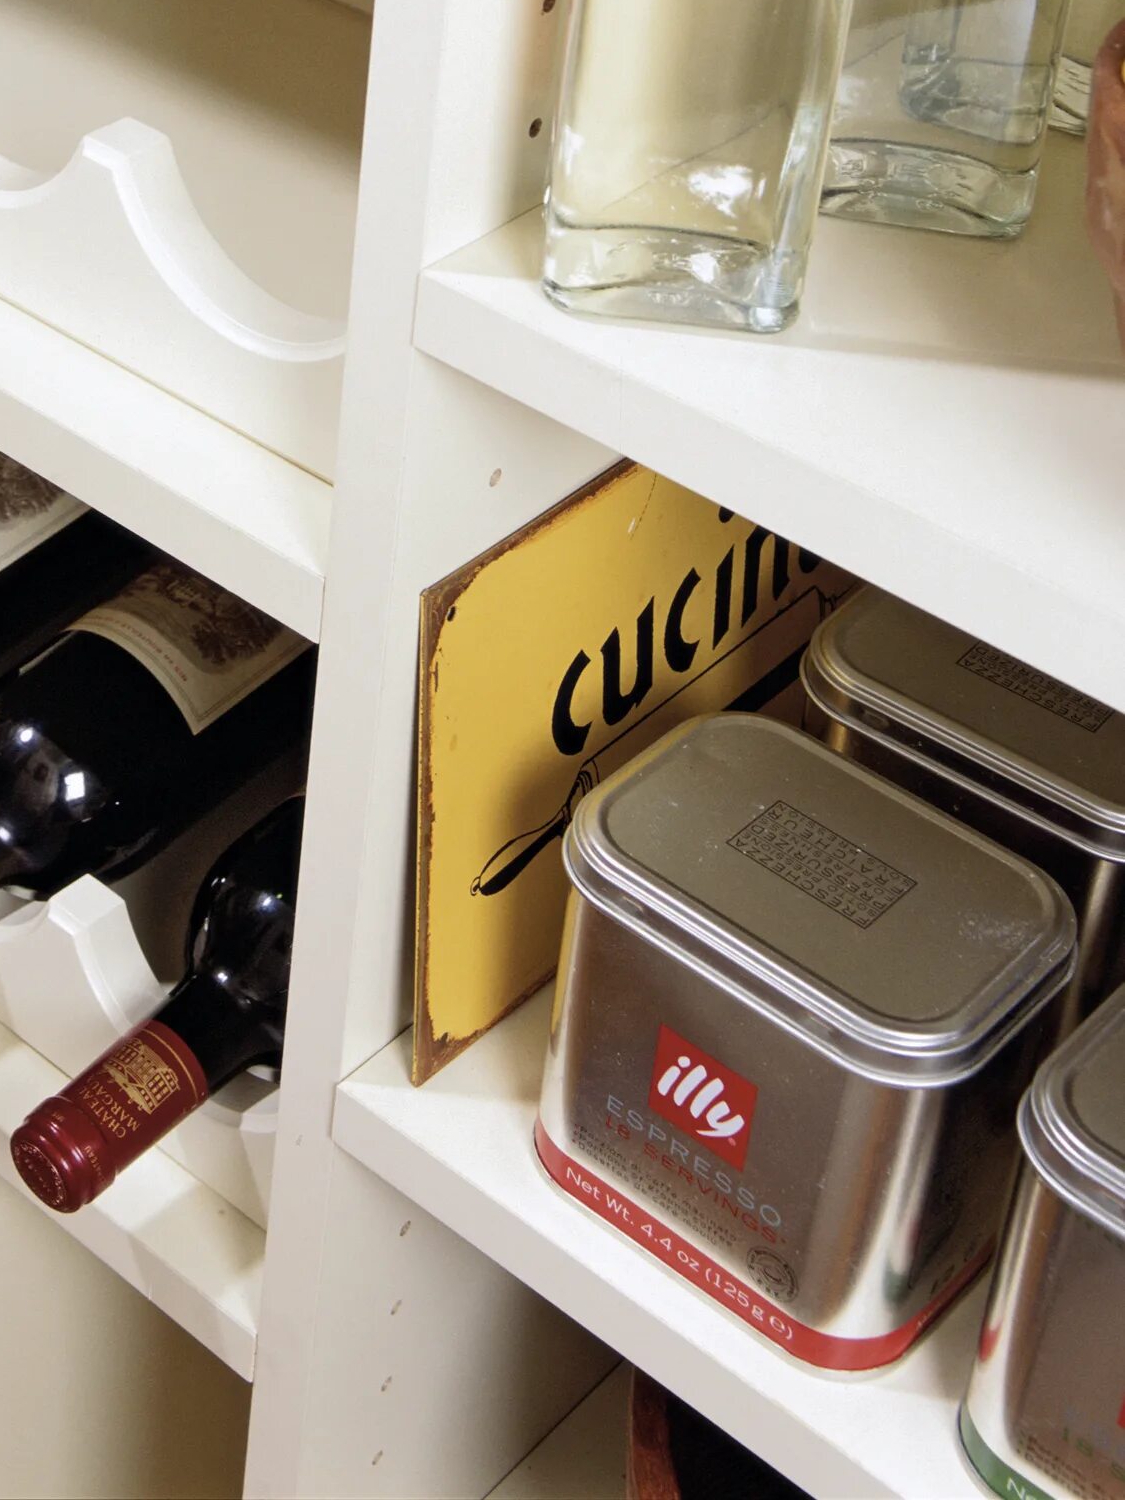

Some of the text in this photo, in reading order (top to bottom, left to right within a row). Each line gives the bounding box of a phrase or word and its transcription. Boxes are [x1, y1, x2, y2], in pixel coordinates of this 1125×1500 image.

[552, 506, 824, 756] cucin
[735, 838, 868, 927] FRESCHEZZA
[742, 832, 823, 884] PRESSIONE
[751, 823, 888, 910] PRESSURIZED
[768, 810, 907, 895] FRAICHEUR
[605, 1113, 631, 1141] 18
[657, 1056, 745, 1138] illy
[607, 1094, 782, 1228] ESPRESSO
[566, 1166, 601, 1201] Net
[605, 1194, 635, 1225] Wt.
[641, 1223, 673, 1252] 4.4
[677, 1250, 701, 1272] oz
[705, 1267, 750, 1308] (125
